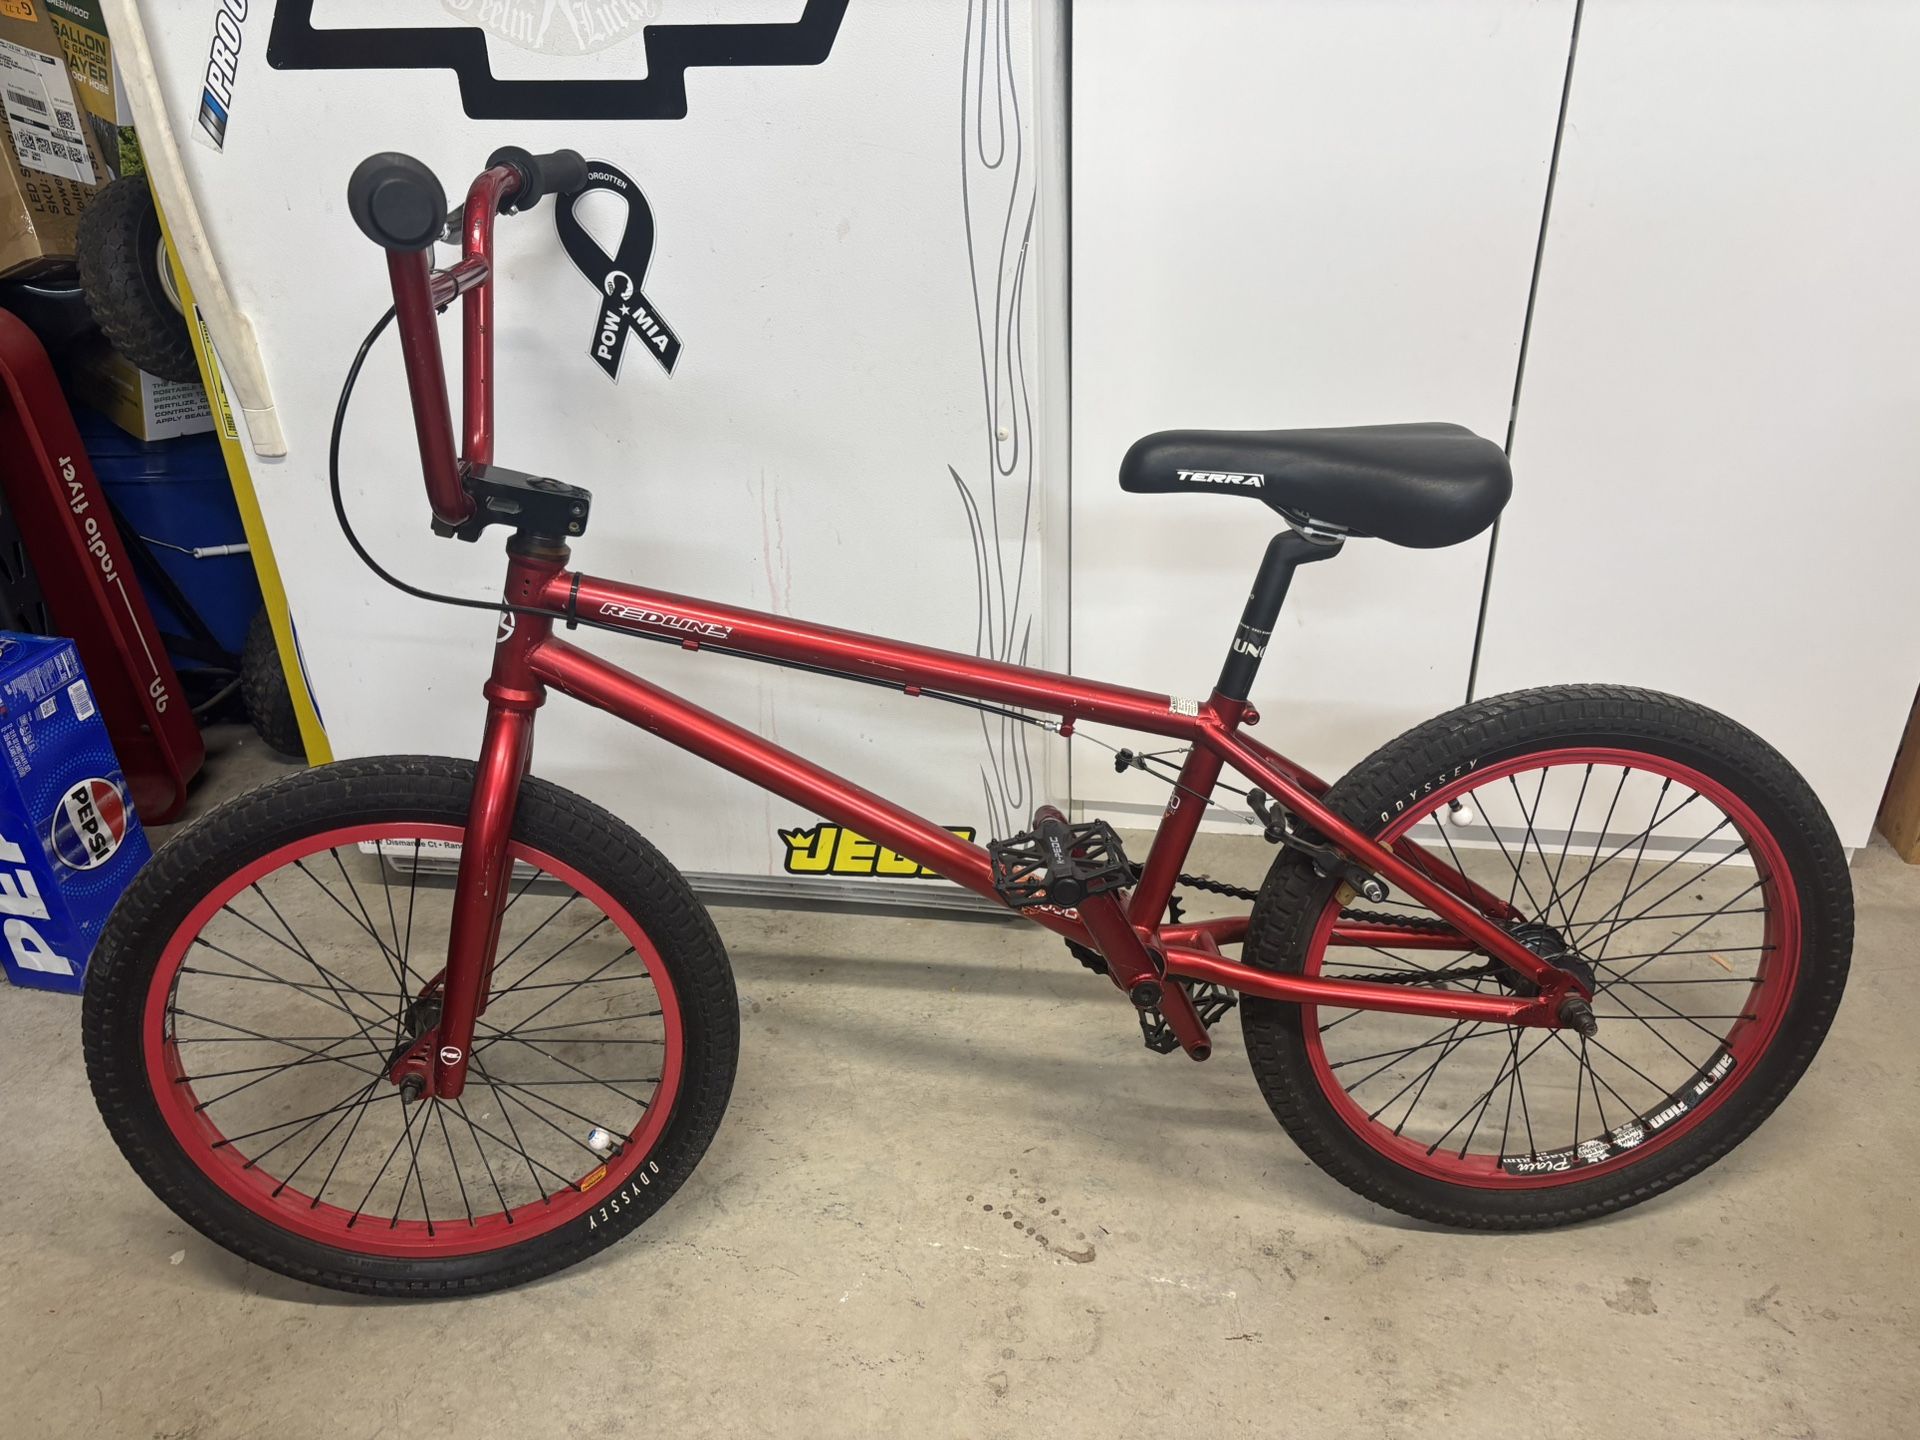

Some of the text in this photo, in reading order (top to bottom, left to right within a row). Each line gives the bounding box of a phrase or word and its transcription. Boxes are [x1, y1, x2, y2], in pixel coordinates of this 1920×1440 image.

[72, 43, 108, 66] GARDEN
[64, 50, 109, 84] AYER
[71, 71, 109, 95] OOT HOSE
[587, 171, 629, 190] ORGOTTEN
[26, 182, 45, 212] LED
[597, 310, 621, 360] POW
[632, 307, 670, 353] MIA
[153, 392, 193, 403] SPRAYER
[154, 399, 198, 410] FERTILIZE,
[155, 407, 195, 418] CONTROL
[155, 415, 182, 425] APPLY
[58, 456, 90, 515] flyer
[1176, 469, 1265, 488] TERRA
[85, 517, 118, 583] radio
[1380, 758, 1479, 823] ODYSSEY
[71, 785, 111, 864] PEPSI
[385, 839, 426, 848] Dismane
[428, 841, 438, 849] Ct
[786, 825, 974, 877] JEG
[1517, 1157, 1571, 1171] Plain
[590, 1161, 659, 1230] ODYSSEY
